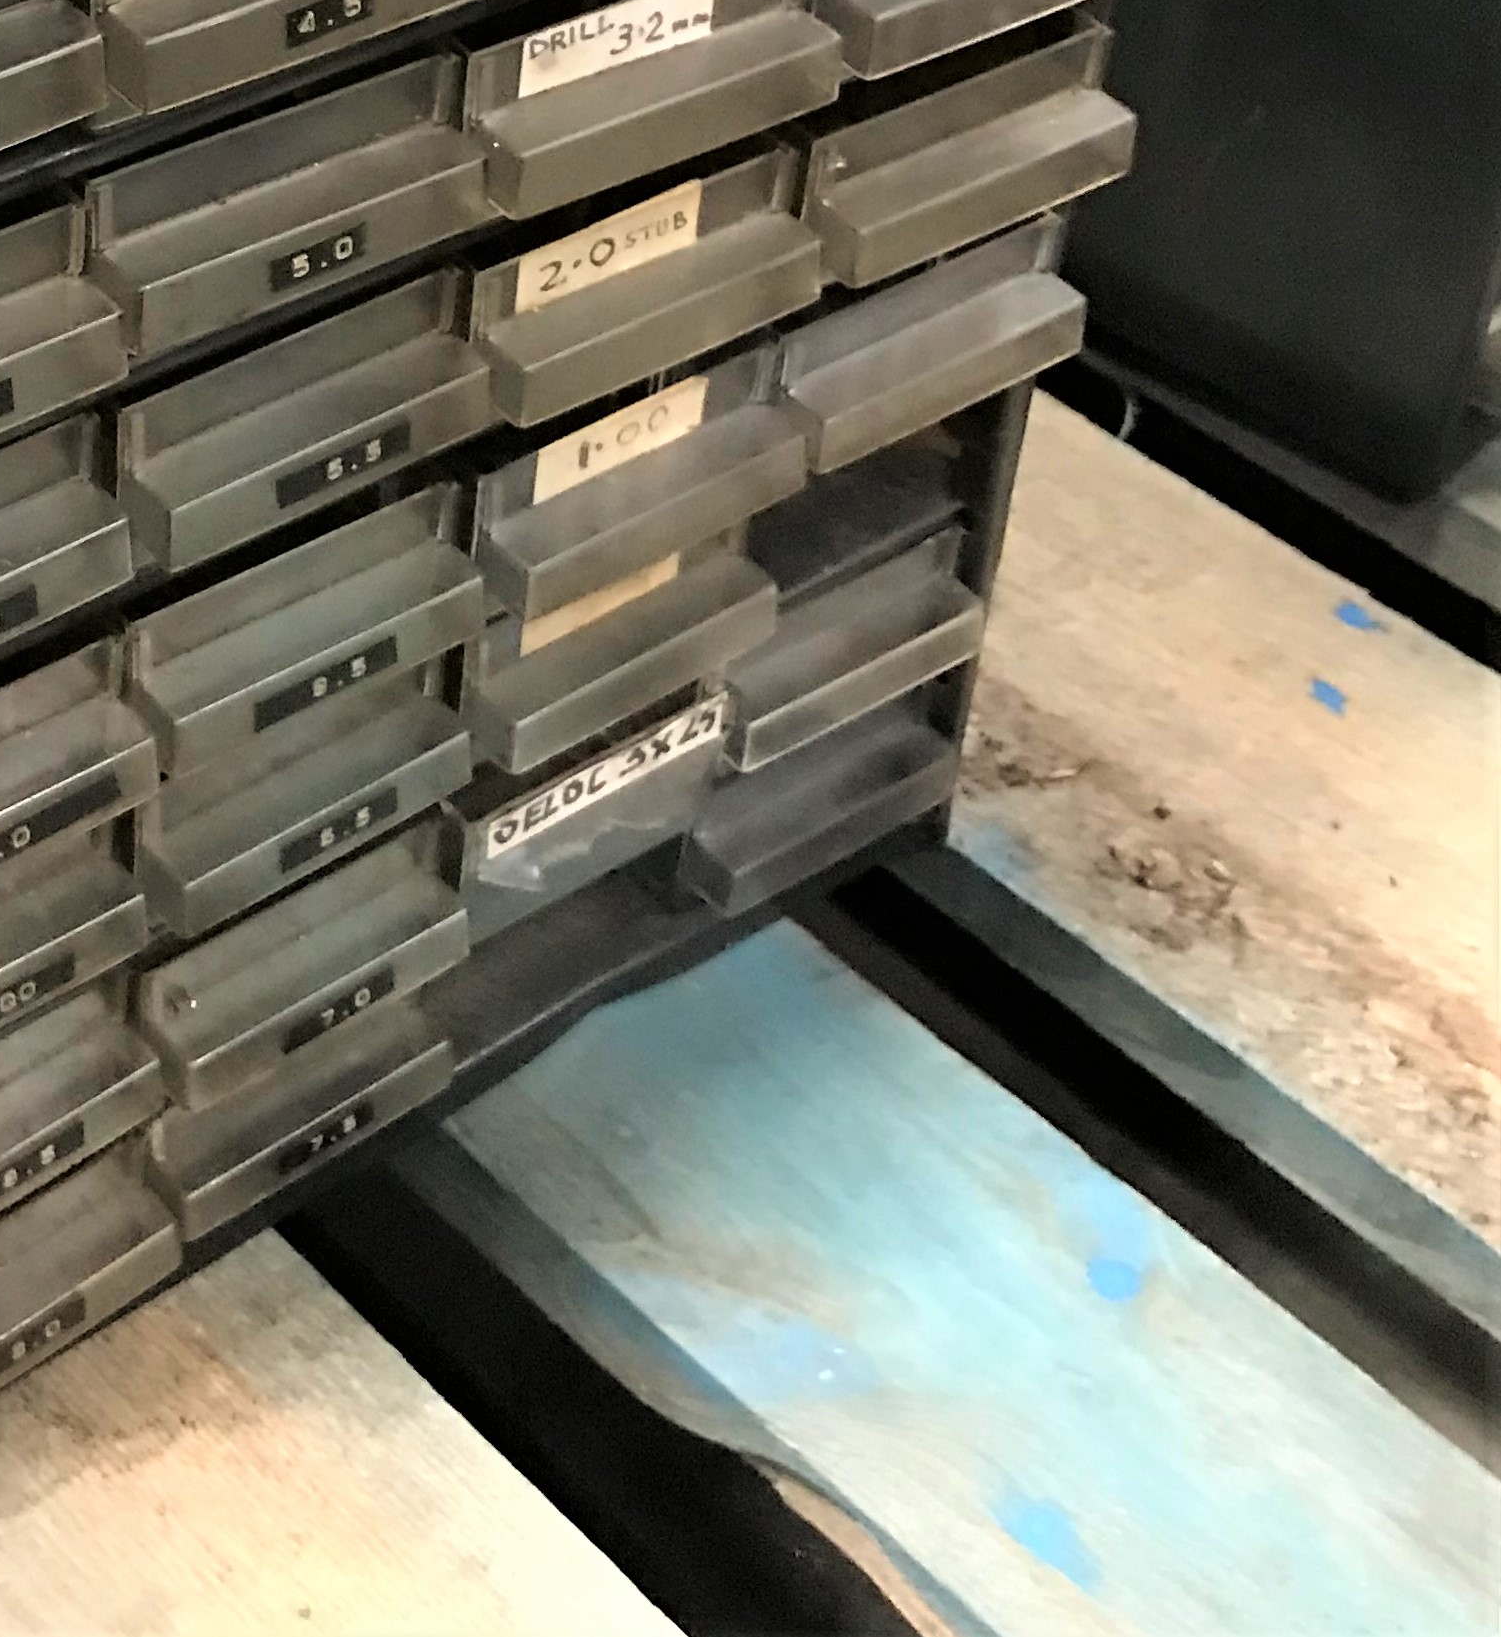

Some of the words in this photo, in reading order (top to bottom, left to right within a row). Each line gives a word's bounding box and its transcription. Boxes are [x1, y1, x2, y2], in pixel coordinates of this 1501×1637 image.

[529, 15, 615, 59] DRILL
[625, 211, 688, 250] STUB
[292, 236, 353, 278] 5.0
[327, 439, 382, 481] 5.5
[320, 987, 371, 1027] 7.0
